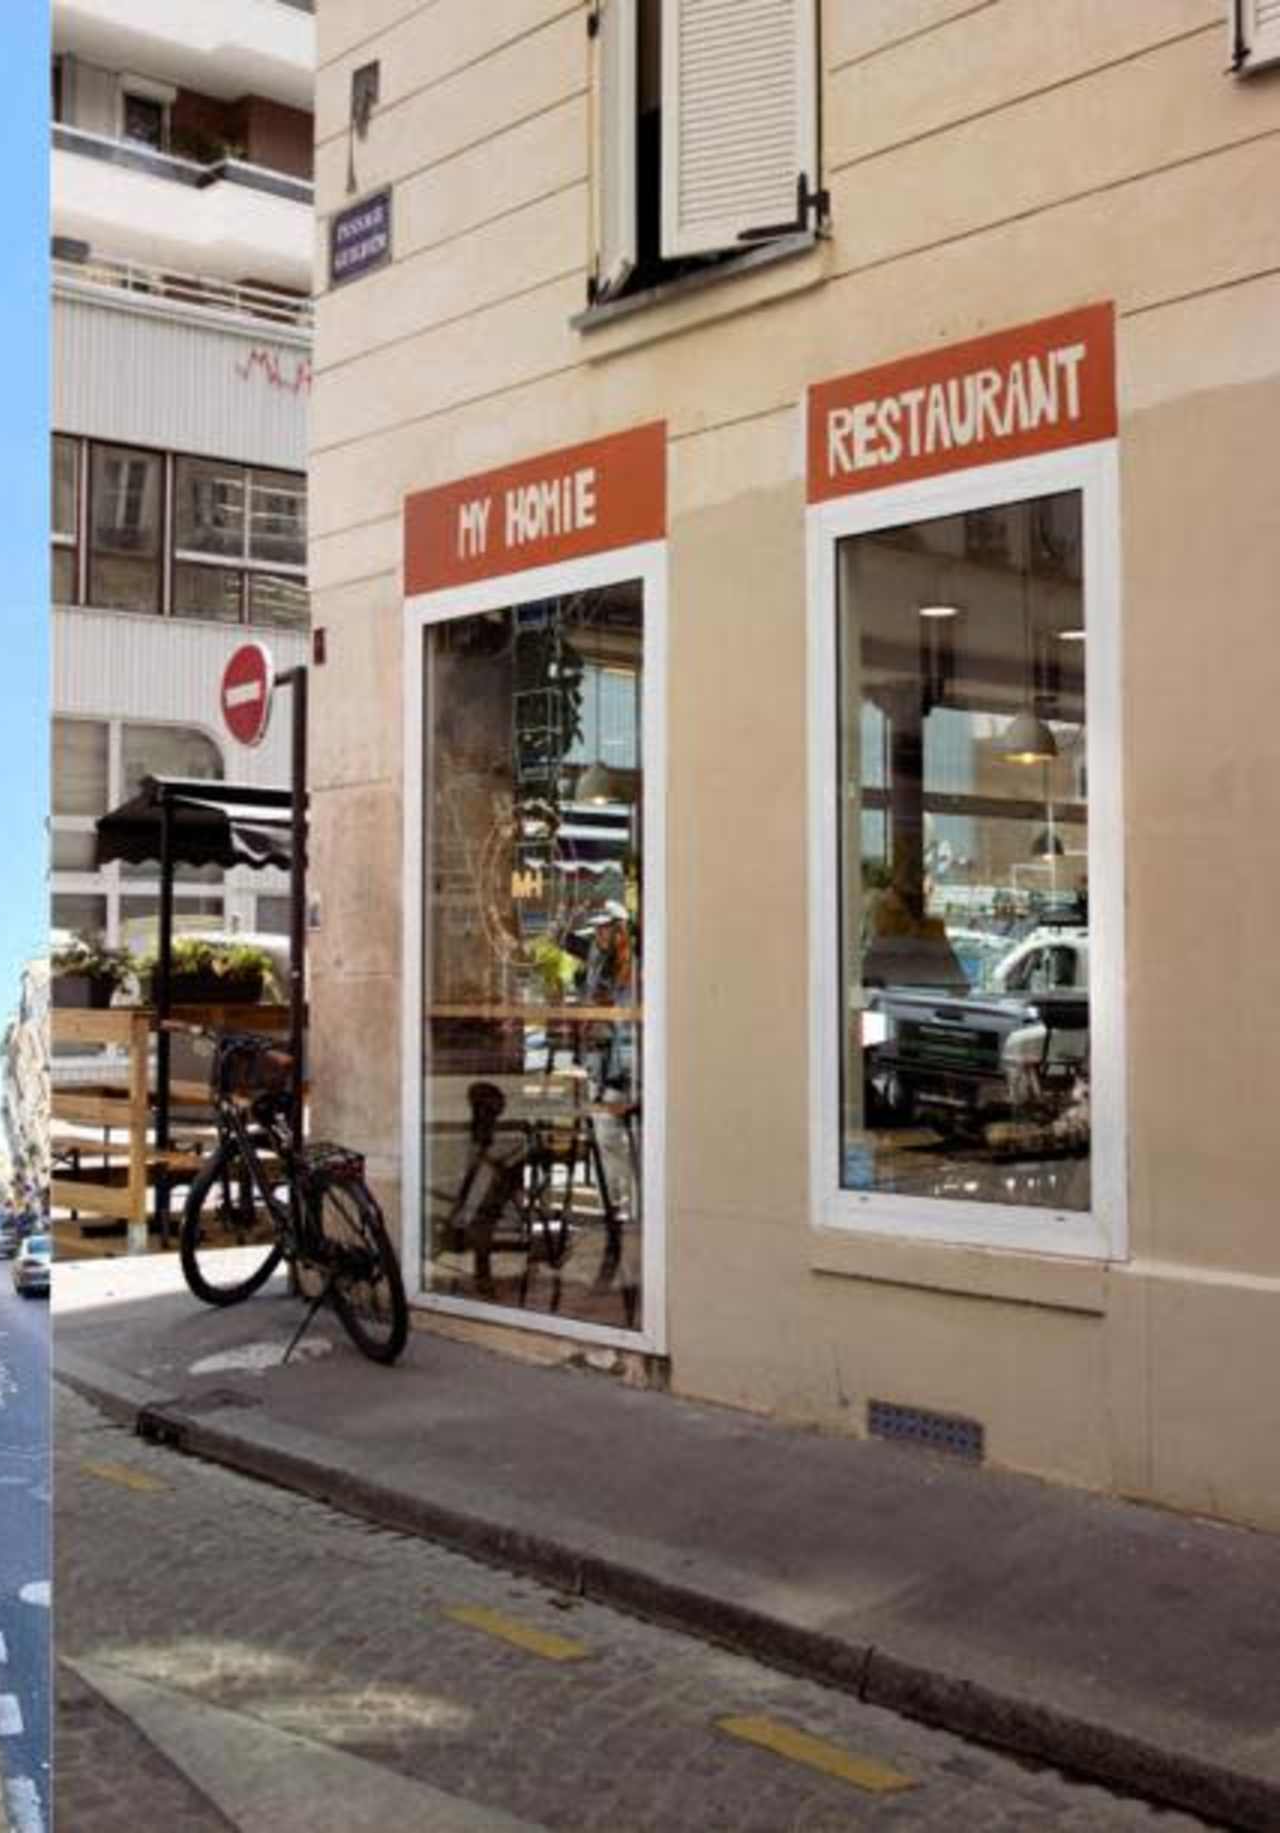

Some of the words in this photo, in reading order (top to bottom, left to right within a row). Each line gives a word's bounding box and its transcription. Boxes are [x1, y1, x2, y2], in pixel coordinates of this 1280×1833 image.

[826, 343, 1087, 478] RESTAURANT
[457, 496, 493, 561] MY
[504, 467, 597, 547] HOMIE
